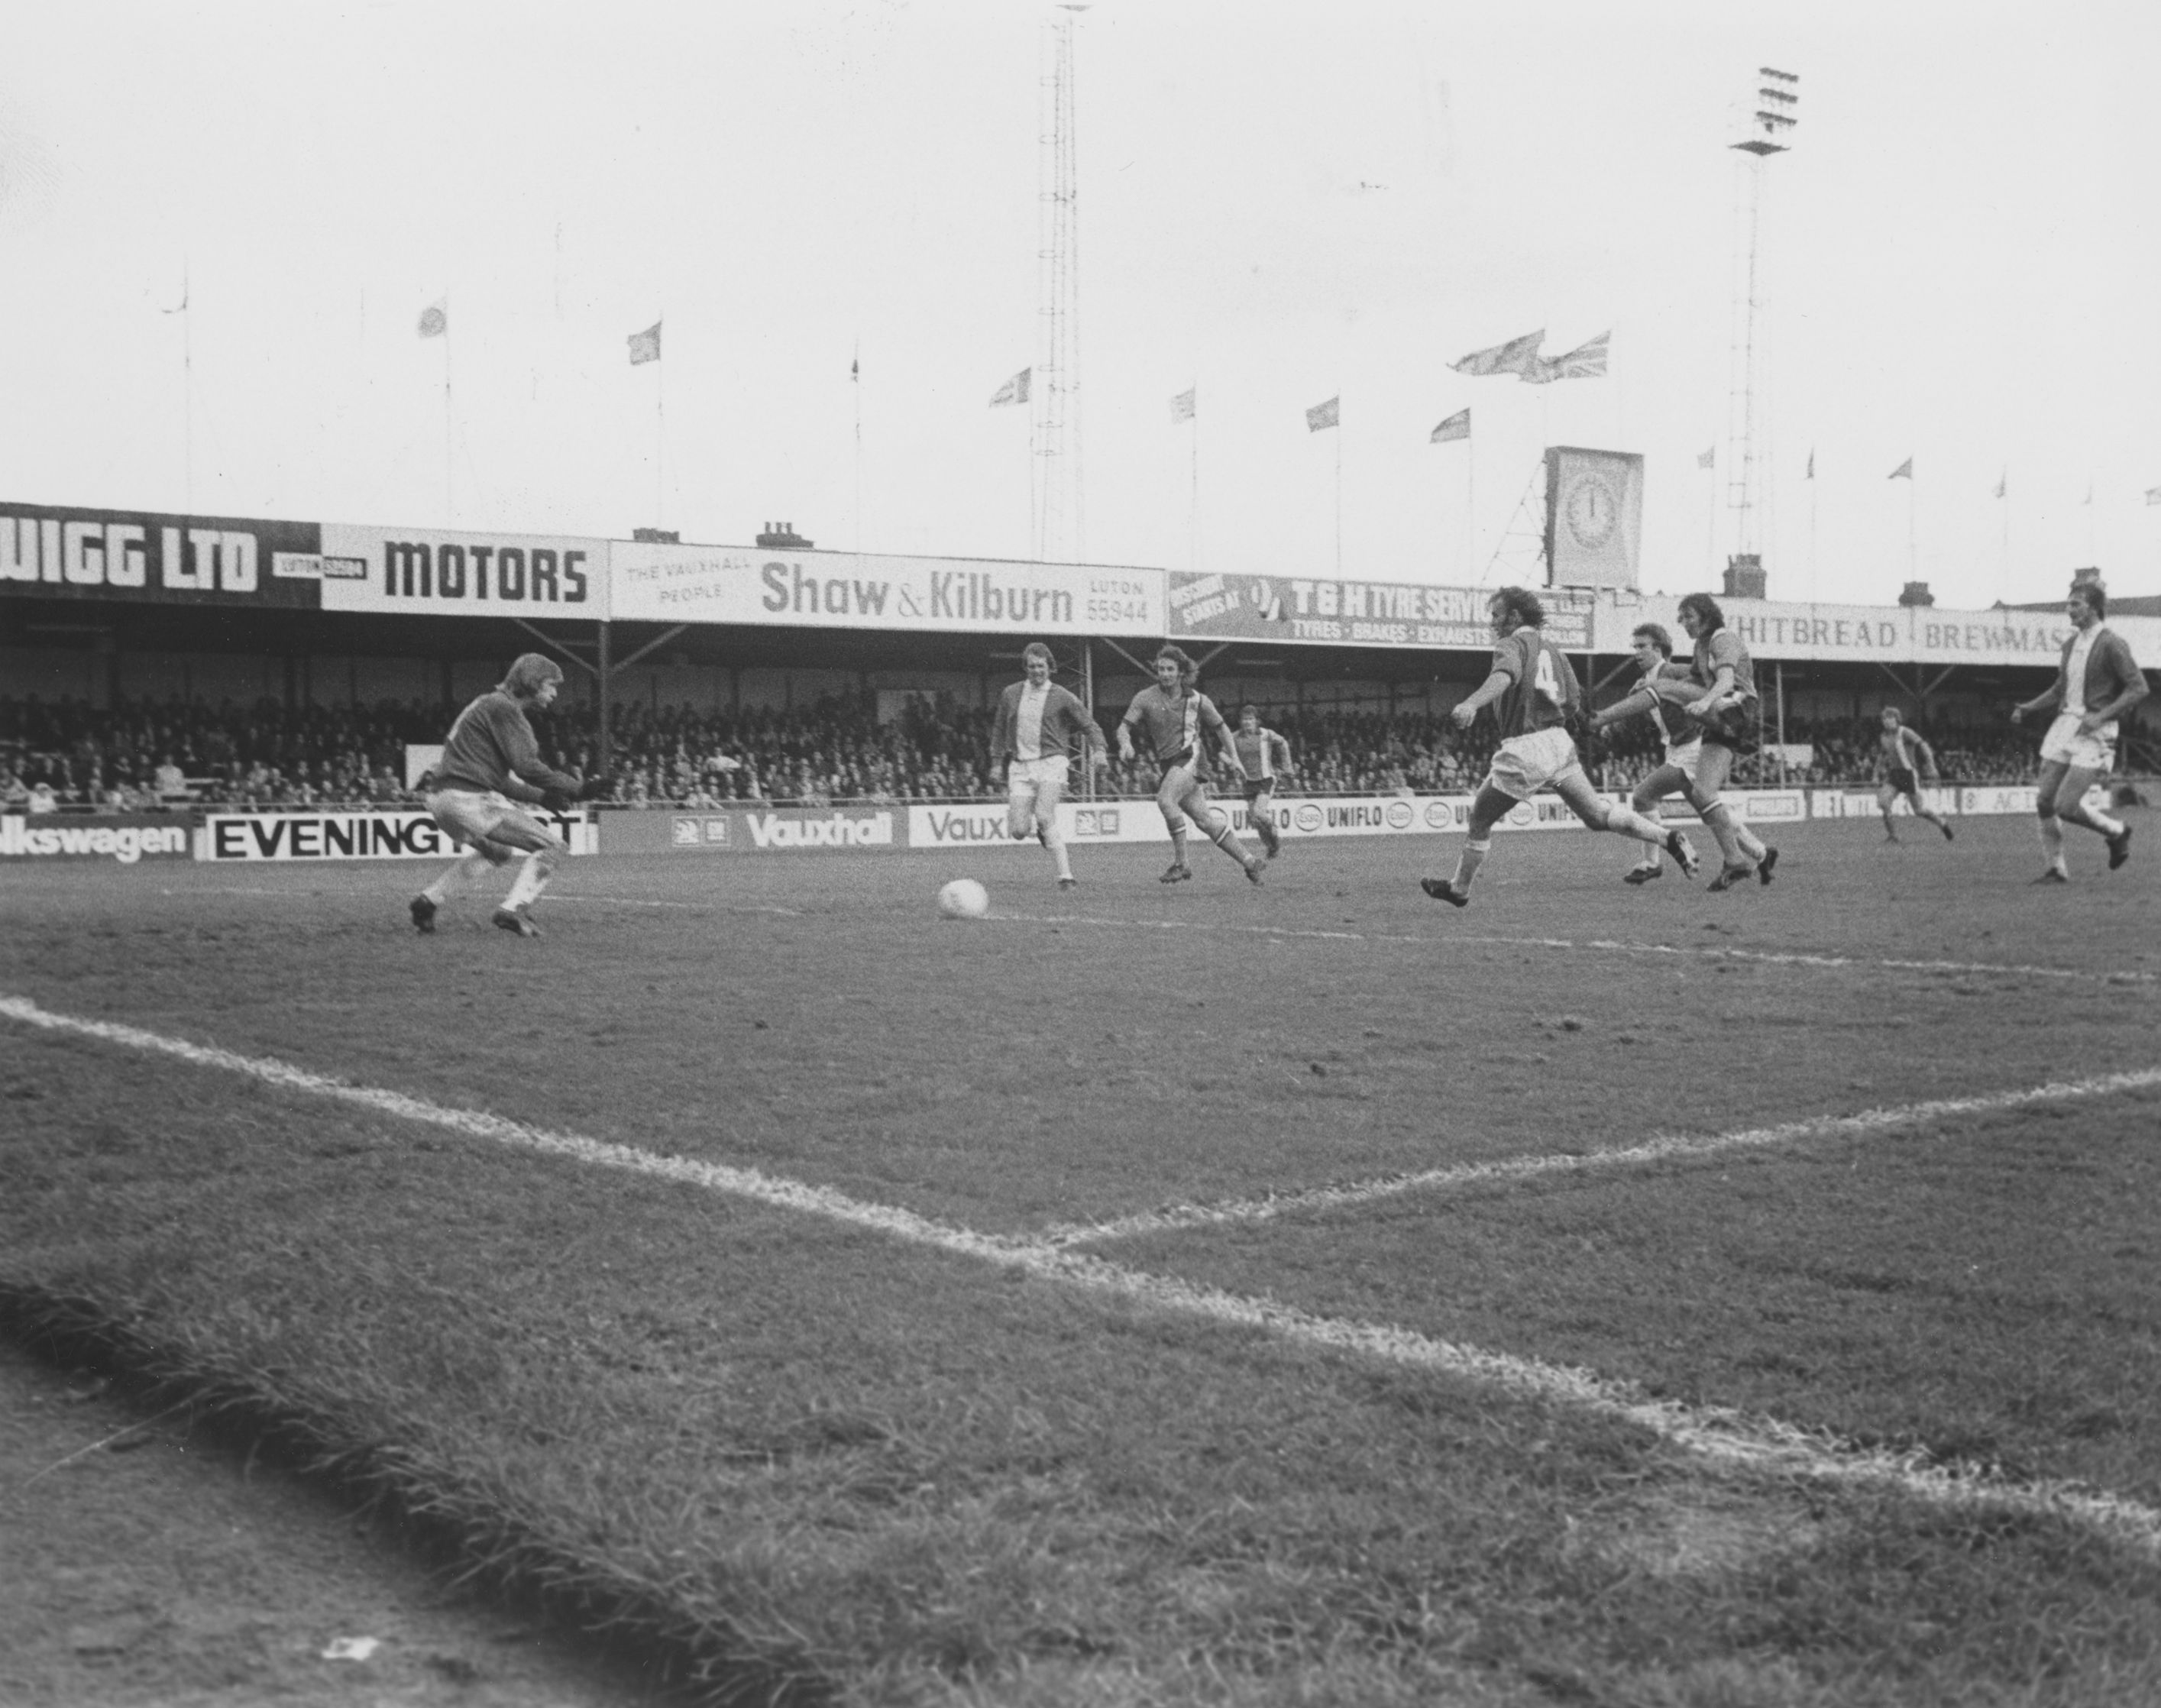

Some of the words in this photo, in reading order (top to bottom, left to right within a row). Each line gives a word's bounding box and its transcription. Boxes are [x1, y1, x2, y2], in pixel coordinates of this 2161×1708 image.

[161, 527, 257, 591] LTD
[385, 541, 587, 602] MOTORS
[659, 583, 723, 603] PEOPLE
[762, 562, 889, 616] Shaw
[898, 583, 924, 617] &
[930, 571, 1072, 622] Kilburn
[1089, 579, 1144, 595] LUTON
[1370, 586, 1422, 620] TYRE
[1425, 589, 1493, 623] SERVIC
[1729, 614, 1897, 648] HITBREAD
[1926, 623, 2067, 652] BREWMAS
[1535, 649, 1558, 700] 4
[746, 811, 892, 848] Vauxhall
[1327, 805, 1383, 828] UNIFLO
[0, 814, 187, 863] lkswagen
[215, 817, 440, 859] EVENING
